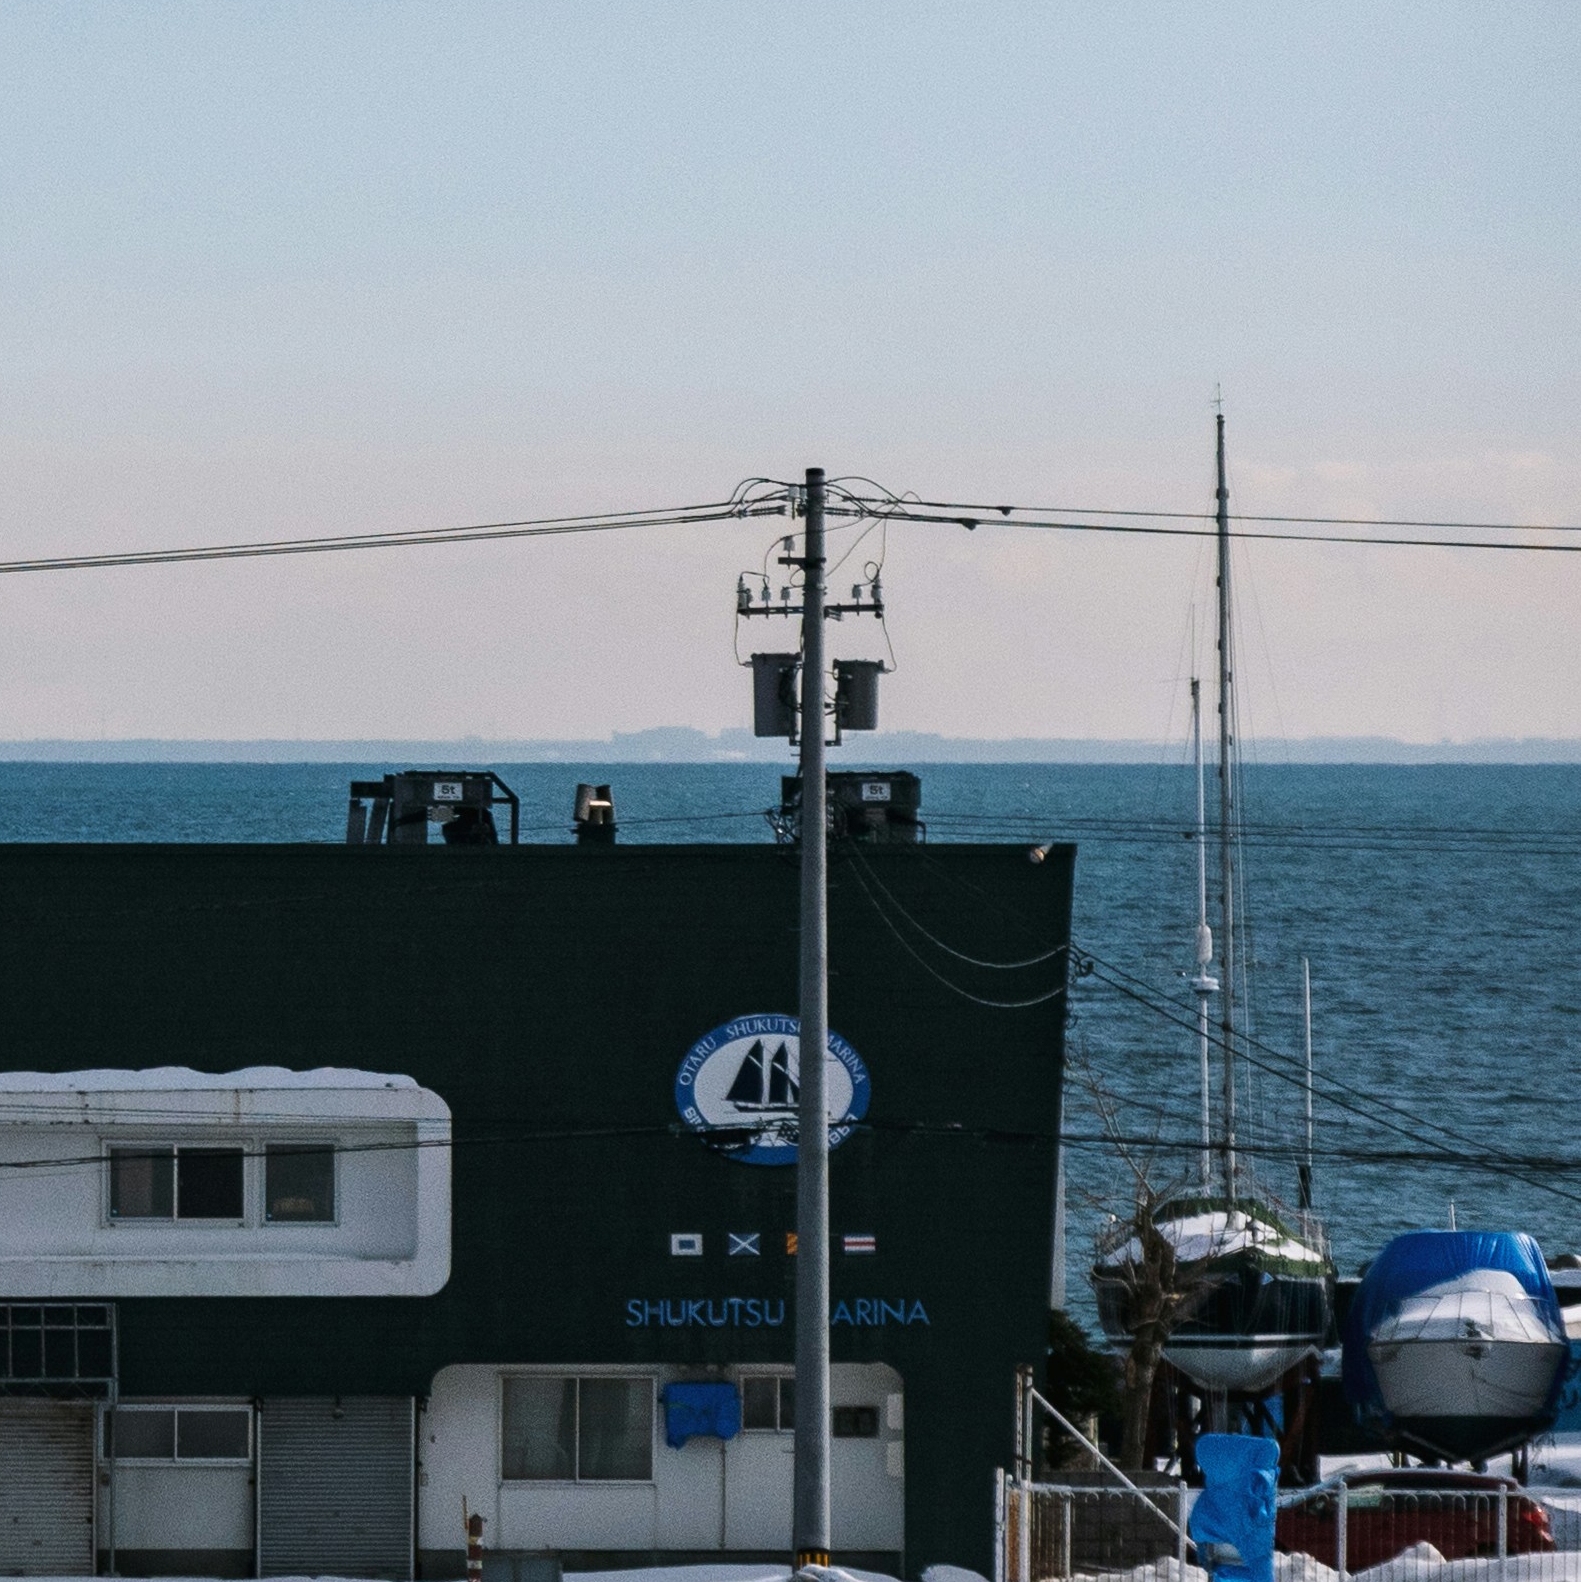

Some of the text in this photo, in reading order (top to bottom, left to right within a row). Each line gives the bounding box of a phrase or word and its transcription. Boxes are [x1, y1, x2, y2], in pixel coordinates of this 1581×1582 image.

[679, 1036, 717, 1086] OTARU
[726, 1018, 800, 1039] SHUKUTS
[625, 1298, 930, 1327] SHUKUTSU ARINA
